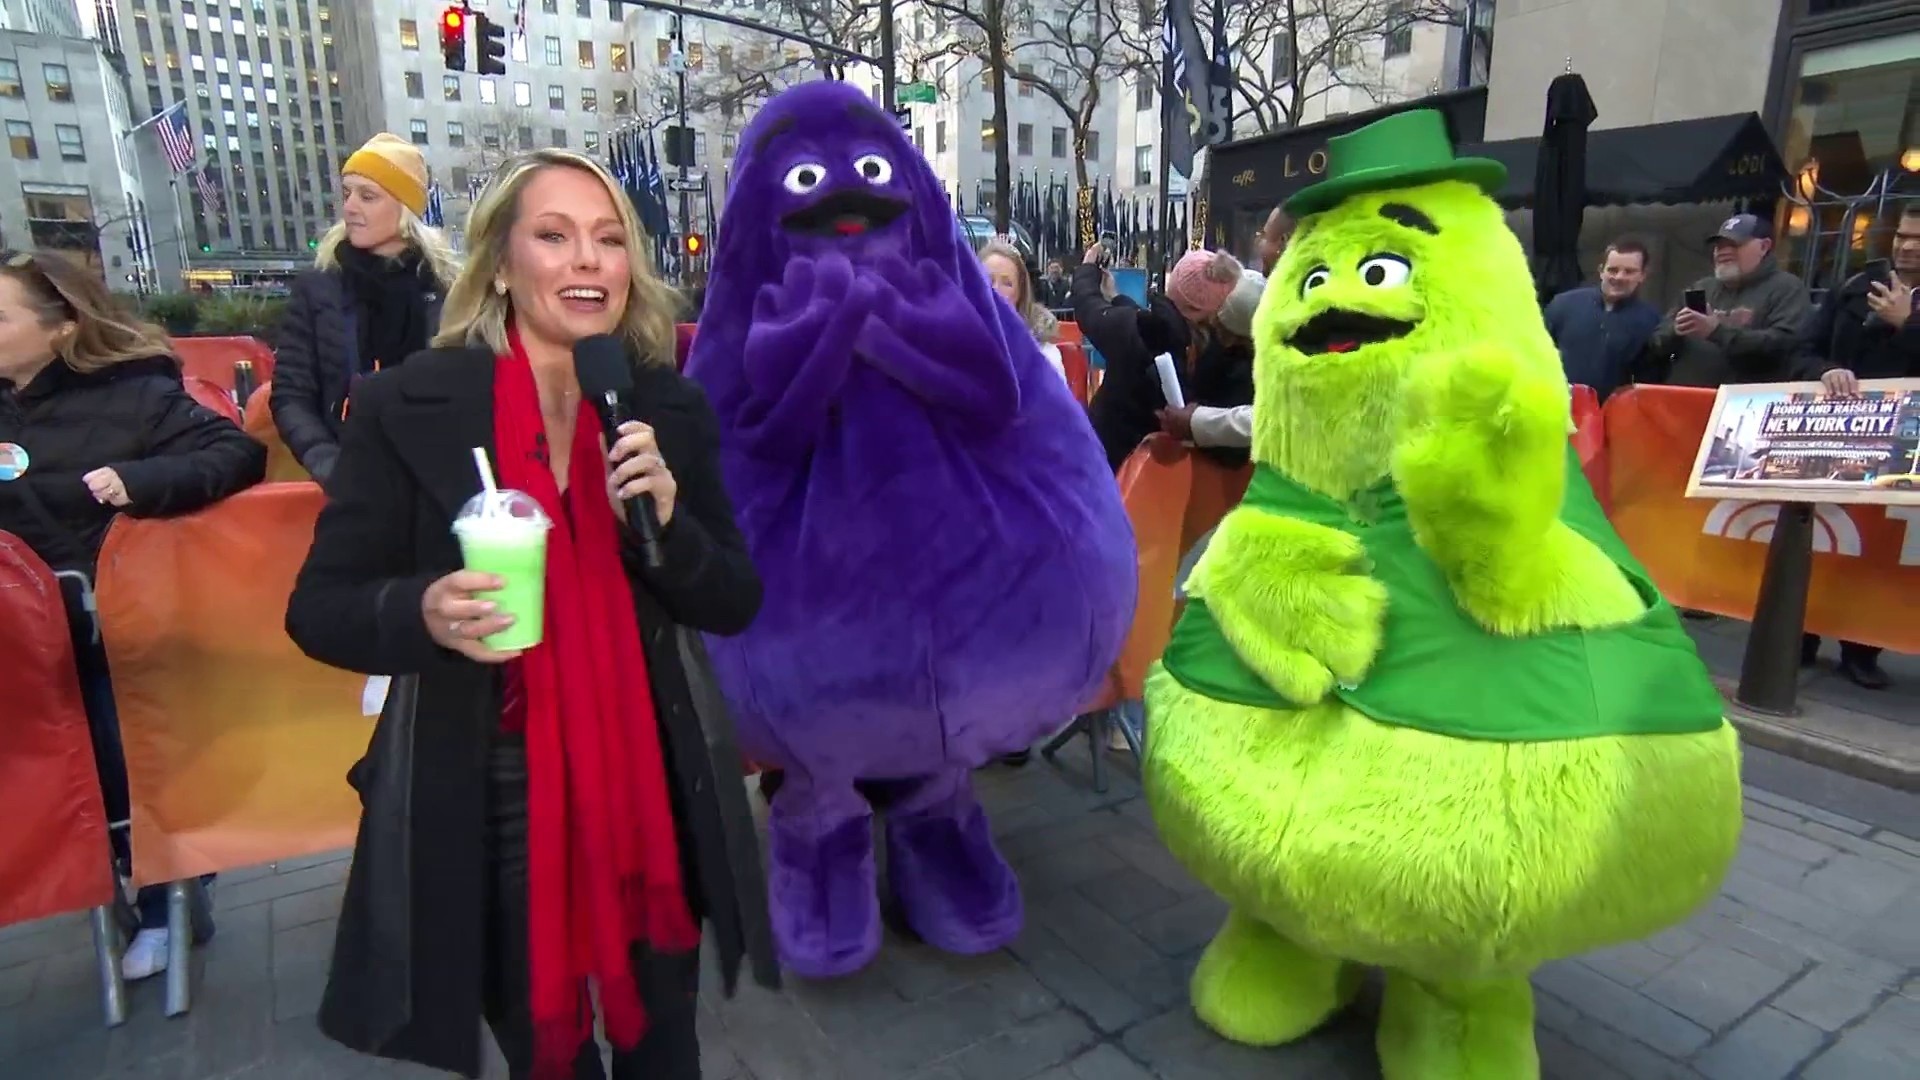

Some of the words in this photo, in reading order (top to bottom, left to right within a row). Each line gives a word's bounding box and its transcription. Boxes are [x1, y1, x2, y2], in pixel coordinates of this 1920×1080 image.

[1284, 151, 1327, 178] LO
[1772, 404, 1805, 415] BORN
[1805, 404, 1832, 414] AND
[1832, 403, 1878, 414] RAISED
[1879, 402, 1894, 413] IN
[1765, 416, 1803, 432] NEW
[1804, 416, 1847, 432] YORK
[1850, 416, 1891, 432] CITY
